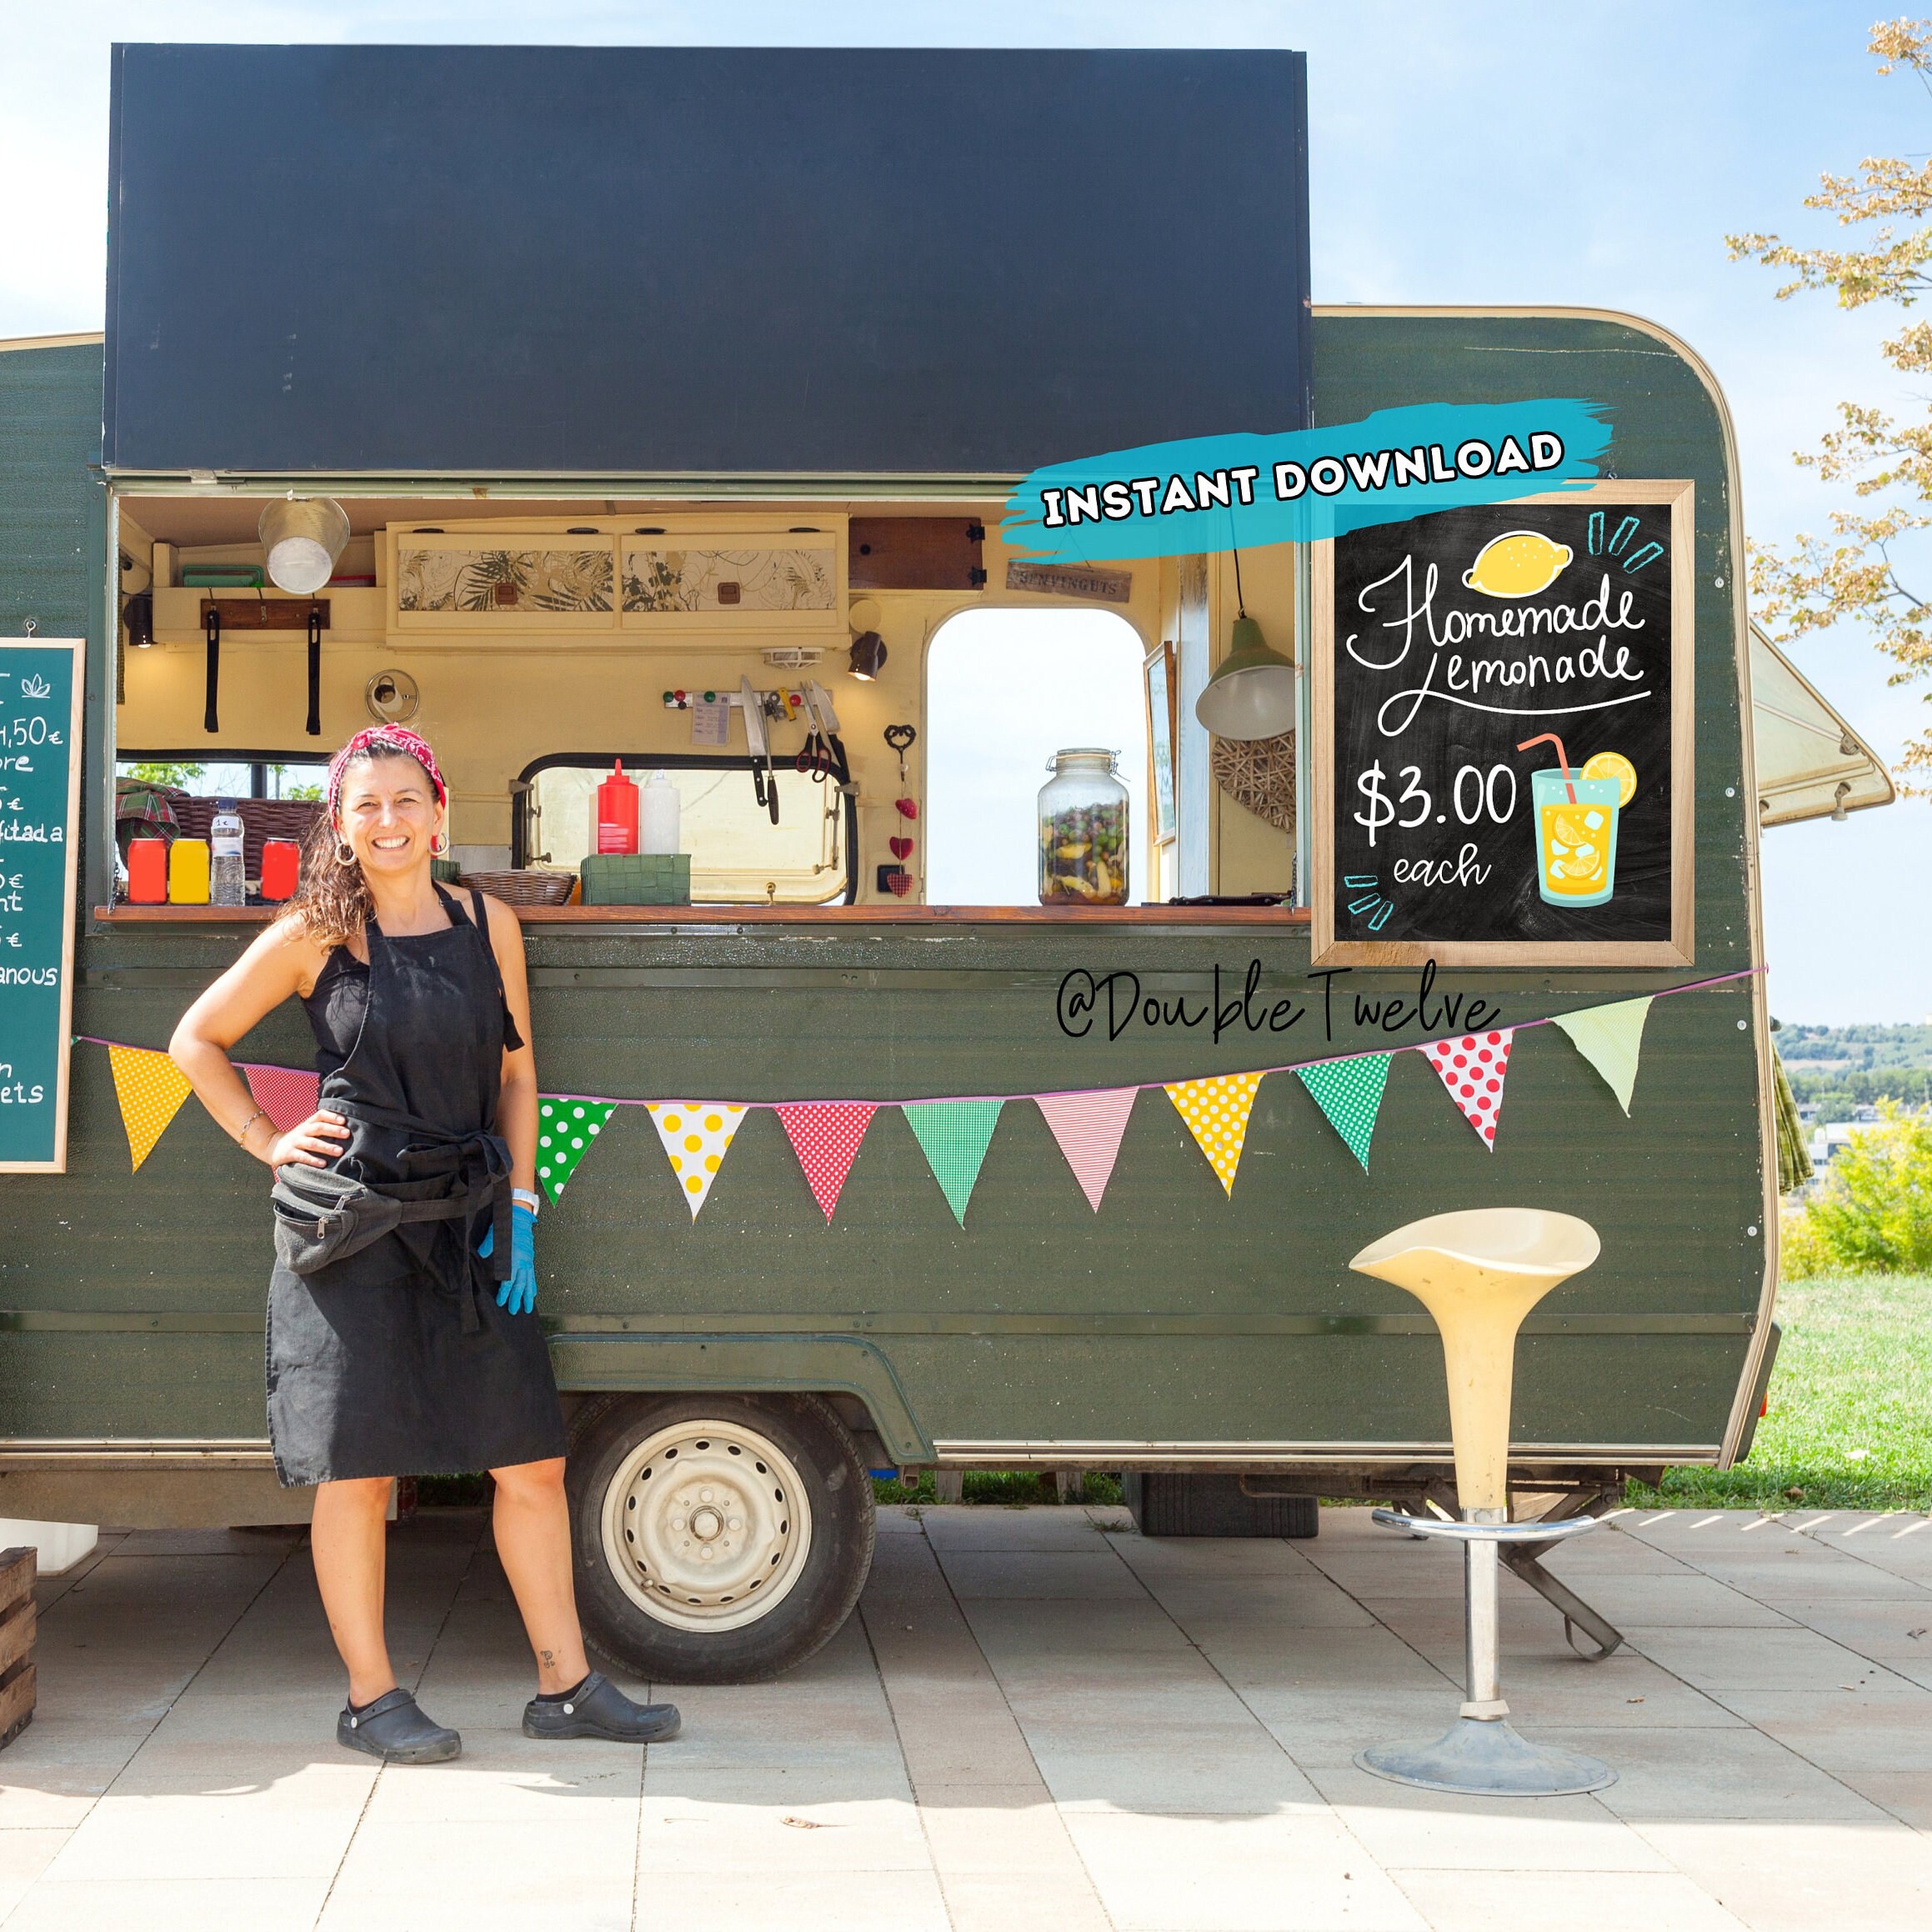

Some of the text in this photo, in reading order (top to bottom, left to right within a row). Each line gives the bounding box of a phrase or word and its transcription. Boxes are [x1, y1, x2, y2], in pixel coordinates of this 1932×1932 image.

[1346, 554, 1645, 670] Homemade
[1377, 634, 1651, 737] Lemonade
[0, 755, 34, 773] re
[1354, 758, 1517, 848] $3.00
[1393, 843, 1493, 888] each
